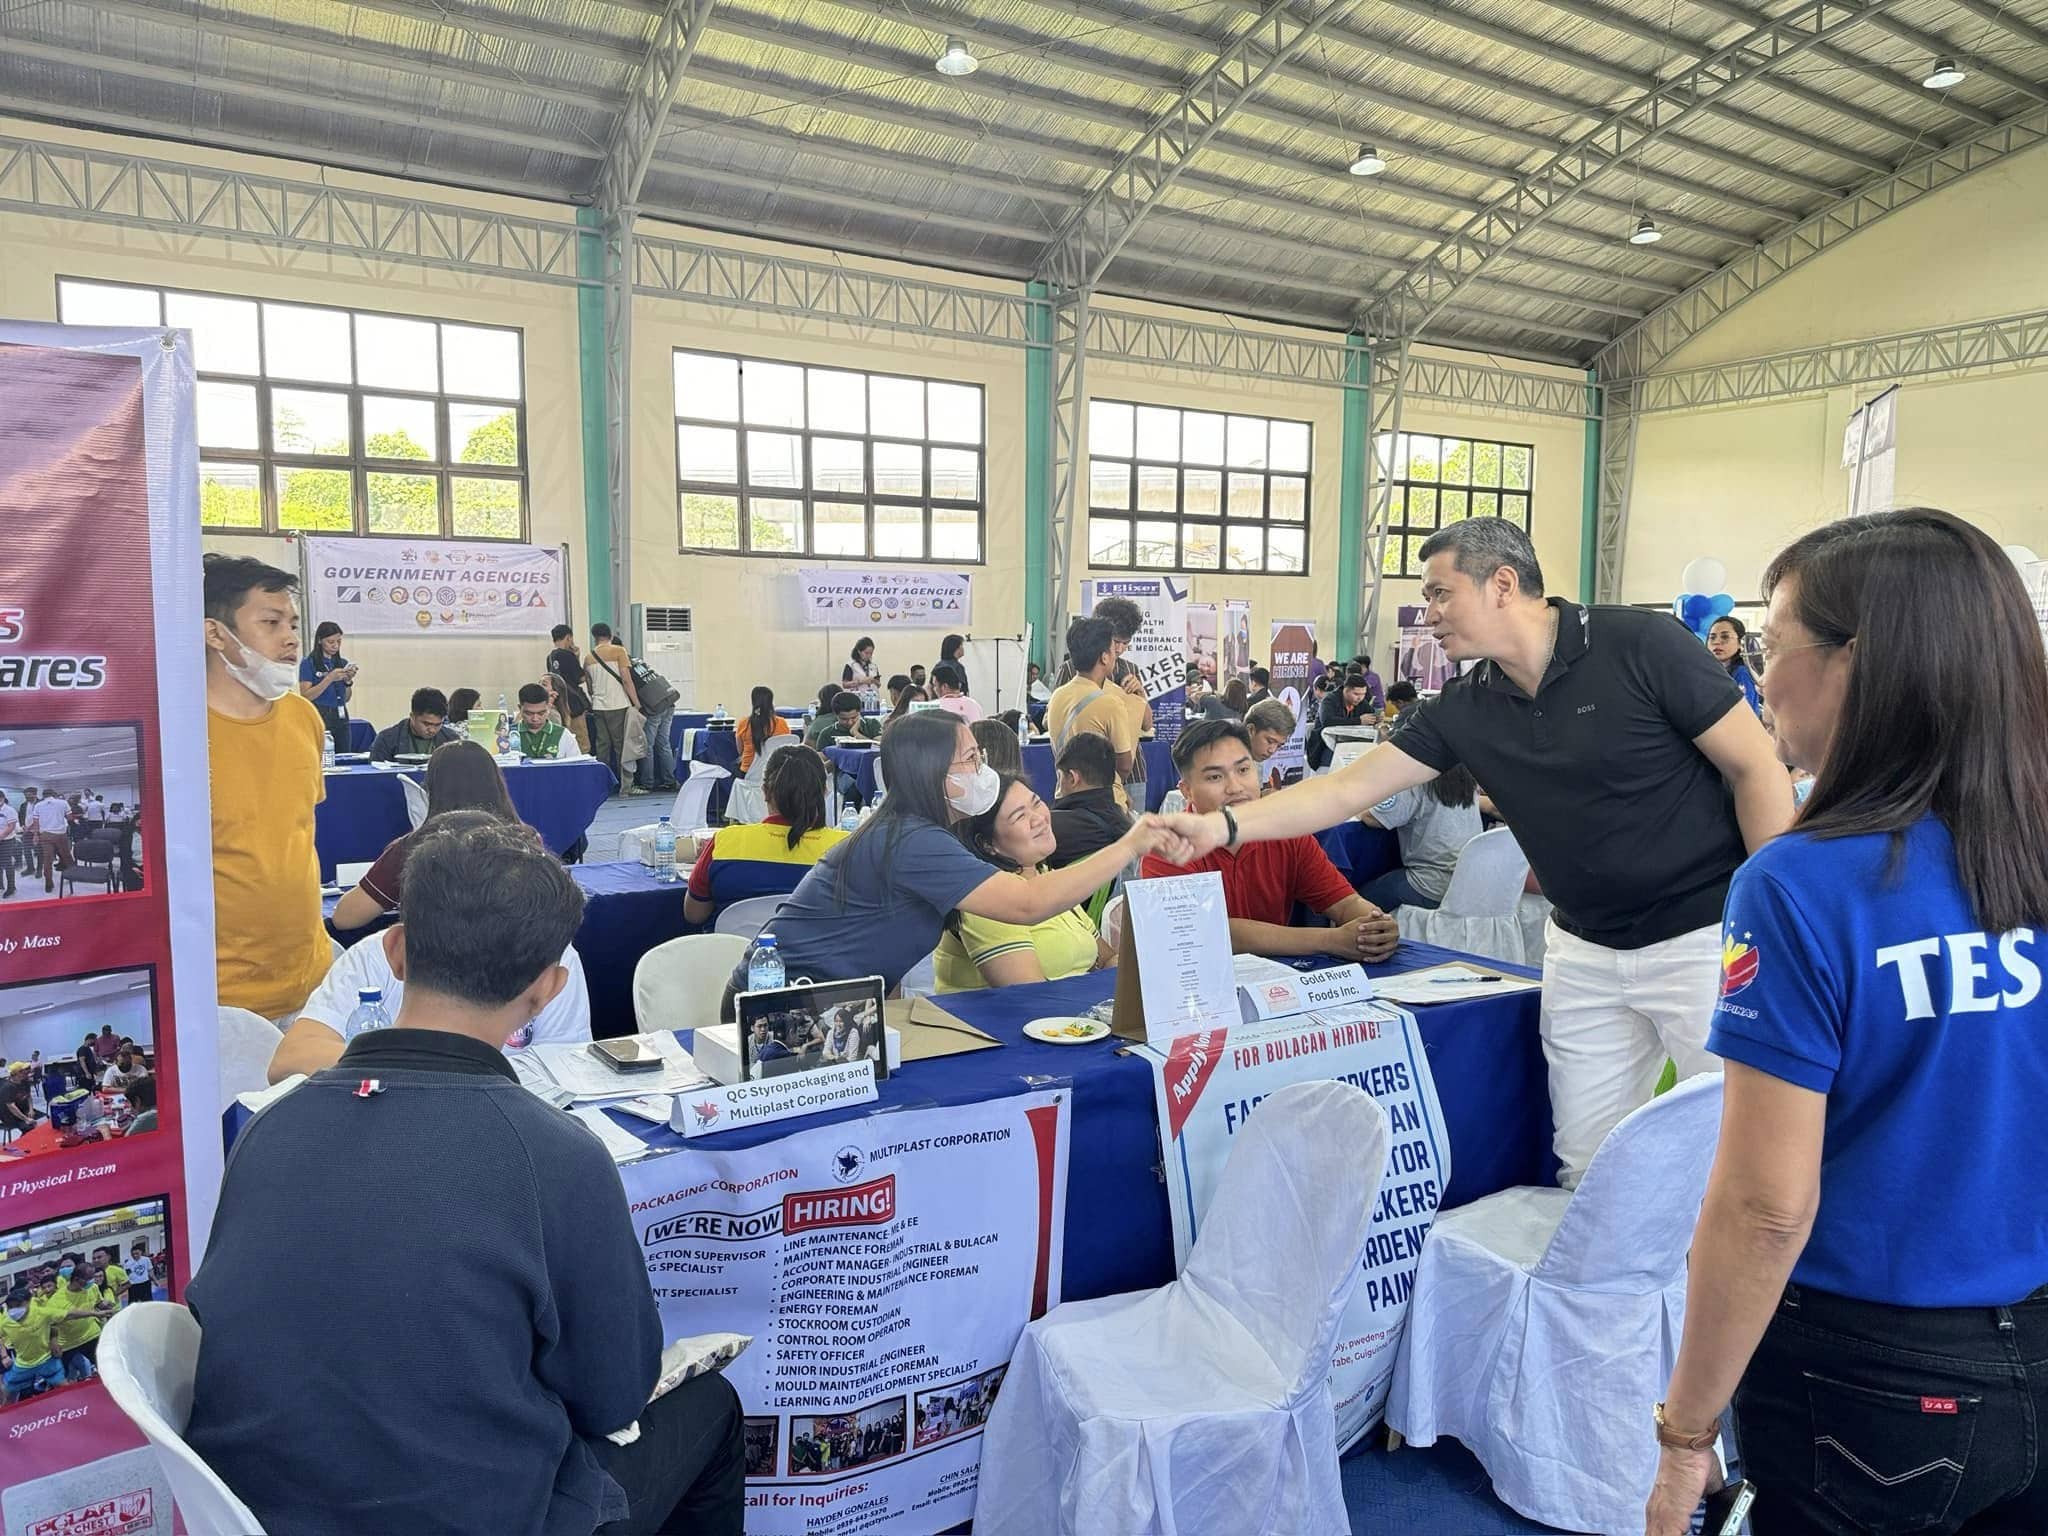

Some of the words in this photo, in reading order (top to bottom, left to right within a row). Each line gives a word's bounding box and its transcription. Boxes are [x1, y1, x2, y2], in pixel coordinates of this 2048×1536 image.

[324, 566, 456, 582] GOVERNMENT
[460, 571, 550, 584] AGENCIES
[1112, 583, 1159, 592] Elixer
[807, 585, 898, 596] GOVERNMENT
[902, 587, 963, 596] AGENCIES
[1140, 652, 1186, 682] IXER
[1272, 665, 1309, 679] HIRING!
[1274, 652, 1290, 664] WE
[1291, 652, 1309, 664] ARE
[0, 656, 107, 691] ares
[1143, 669, 1186, 698] FITS
[23, 934, 61, 950] Mass
[1299, 973, 1326, 986] Gold
[1327, 968, 1352, 982] River
[1308, 988, 1340, 1003] Foods
[1342, 985, 1360, 998] Inc.
[1234, 1045, 1261, 1071] FOR
[1267, 1030, 1328, 1063] BULACAN
[1331, 1021, 1381, 1049] HIRING!
[726, 1087, 748, 1103] QC
[750, 1070, 845, 1099] Styropackaging
[847, 1065, 870, 1079] and
[1173, 1048, 1208, 1105] Apply
[729, 1097, 796, 1121] Multiplast
[797, 1084, 870, 1110] Corporation
[1390, 1100, 1421, 1135] AN
[870, 1138, 931, 1163] MULTIPLAST
[934, 1127, 1011, 1148] CORPORATION
[1386, 1140, 1431, 1178] TOR
[10, 1169, 73, 1199] Physical
[77, 1162, 117, 1181] Exam
[631, 1183, 708, 1214] PACKAGING
[710, 1168, 799, 1194] CORPORATION
[653, 1216, 722, 1240] WE'RE
[727, 1210, 781, 1237] NOW
[793, 1187, 891, 1224] HIRING!
[783, 1237, 807, 1252] LINE
[900, 1220, 906, 1229] &
[907, 1216, 919, 1227] EE
[648, 1250, 692, 1262] ECTION
[694, 1250, 767, 1262] SUPERVISOR
[782, 1259, 834, 1279] ACCOUNT
[944, 1240, 951, 1250] &
[953, 1232, 999, 1250] BULACAN
[783, 1244, 863, 1265] MAINTENANCE
[865, 1235, 904, 1255] FOREMAN
[648, 1264, 657, 1273] G
[659, 1262, 725, 1274] SPECIALIST
[781, 1274, 846, 1291] CORPORATE
[848, 1266, 901, 1287] INDUSTRIAL
[902, 1255, 949, 1275] ENGINEER
[652, 1288, 669, 1298] NT
[780, 1288, 854, 1304] ENGINEERING
[856, 1290, 865, 1301] &
[867, 1269, 928, 1300] MAINTENANCE
[930, 1264, 979, 1282] FOREMAN
[1367, 1267, 1418, 1312] PAIN
[778, 1318, 849, 1331] STOCKROOM
[851, 1306, 901, 1331] CUSTODIAN
[779, 1303, 822, 1315] ENERGY
[825, 1303, 879, 1316] FOREMAN
[777, 1334, 830, 1346] CONTROL
[832, 1334, 866, 1346] ROOM
[868, 1318, 911, 1343] OPERATOR
[1348, 1331, 1385, 1349] pwedeng
[775, 1365, 817, 1377] JUNIOR
[819, 1358, 879, 1376] INDUSTRIAL
[880, 1344, 926, 1364] ENGINEER
[776, 1349, 818, 1361] SAFETY
[820, 1349, 865, 1361] OFFICER
[774, 1380, 817, 1392] MOULD
[819, 1369, 889, 1391] MAINTENANCE
[891, 1355, 939, 1374] FOREMAN
[774, 1396, 831, 1408] LEARNING
[833, 1394, 857, 1406] AND
[858, 1372, 926, 1401] DEVELOPMENT
[927, 1359, 978, 1381] SPECIALIST
[9, 1404, 88, 1440] SportsFest
[939, 1471, 959, 1483] CHIN
[959, 1463, 981, 1476] SALA
[772, 1493, 796, 1507] for
[800, 1481, 869, 1509] Inquiries:
[911, 1500, 932, 1511] Email:
[74, 1516, 109, 1534] CHEST
[806, 1510, 843, 1527] HAYDEN
[844, 1495, 889, 1515] GONZALES
